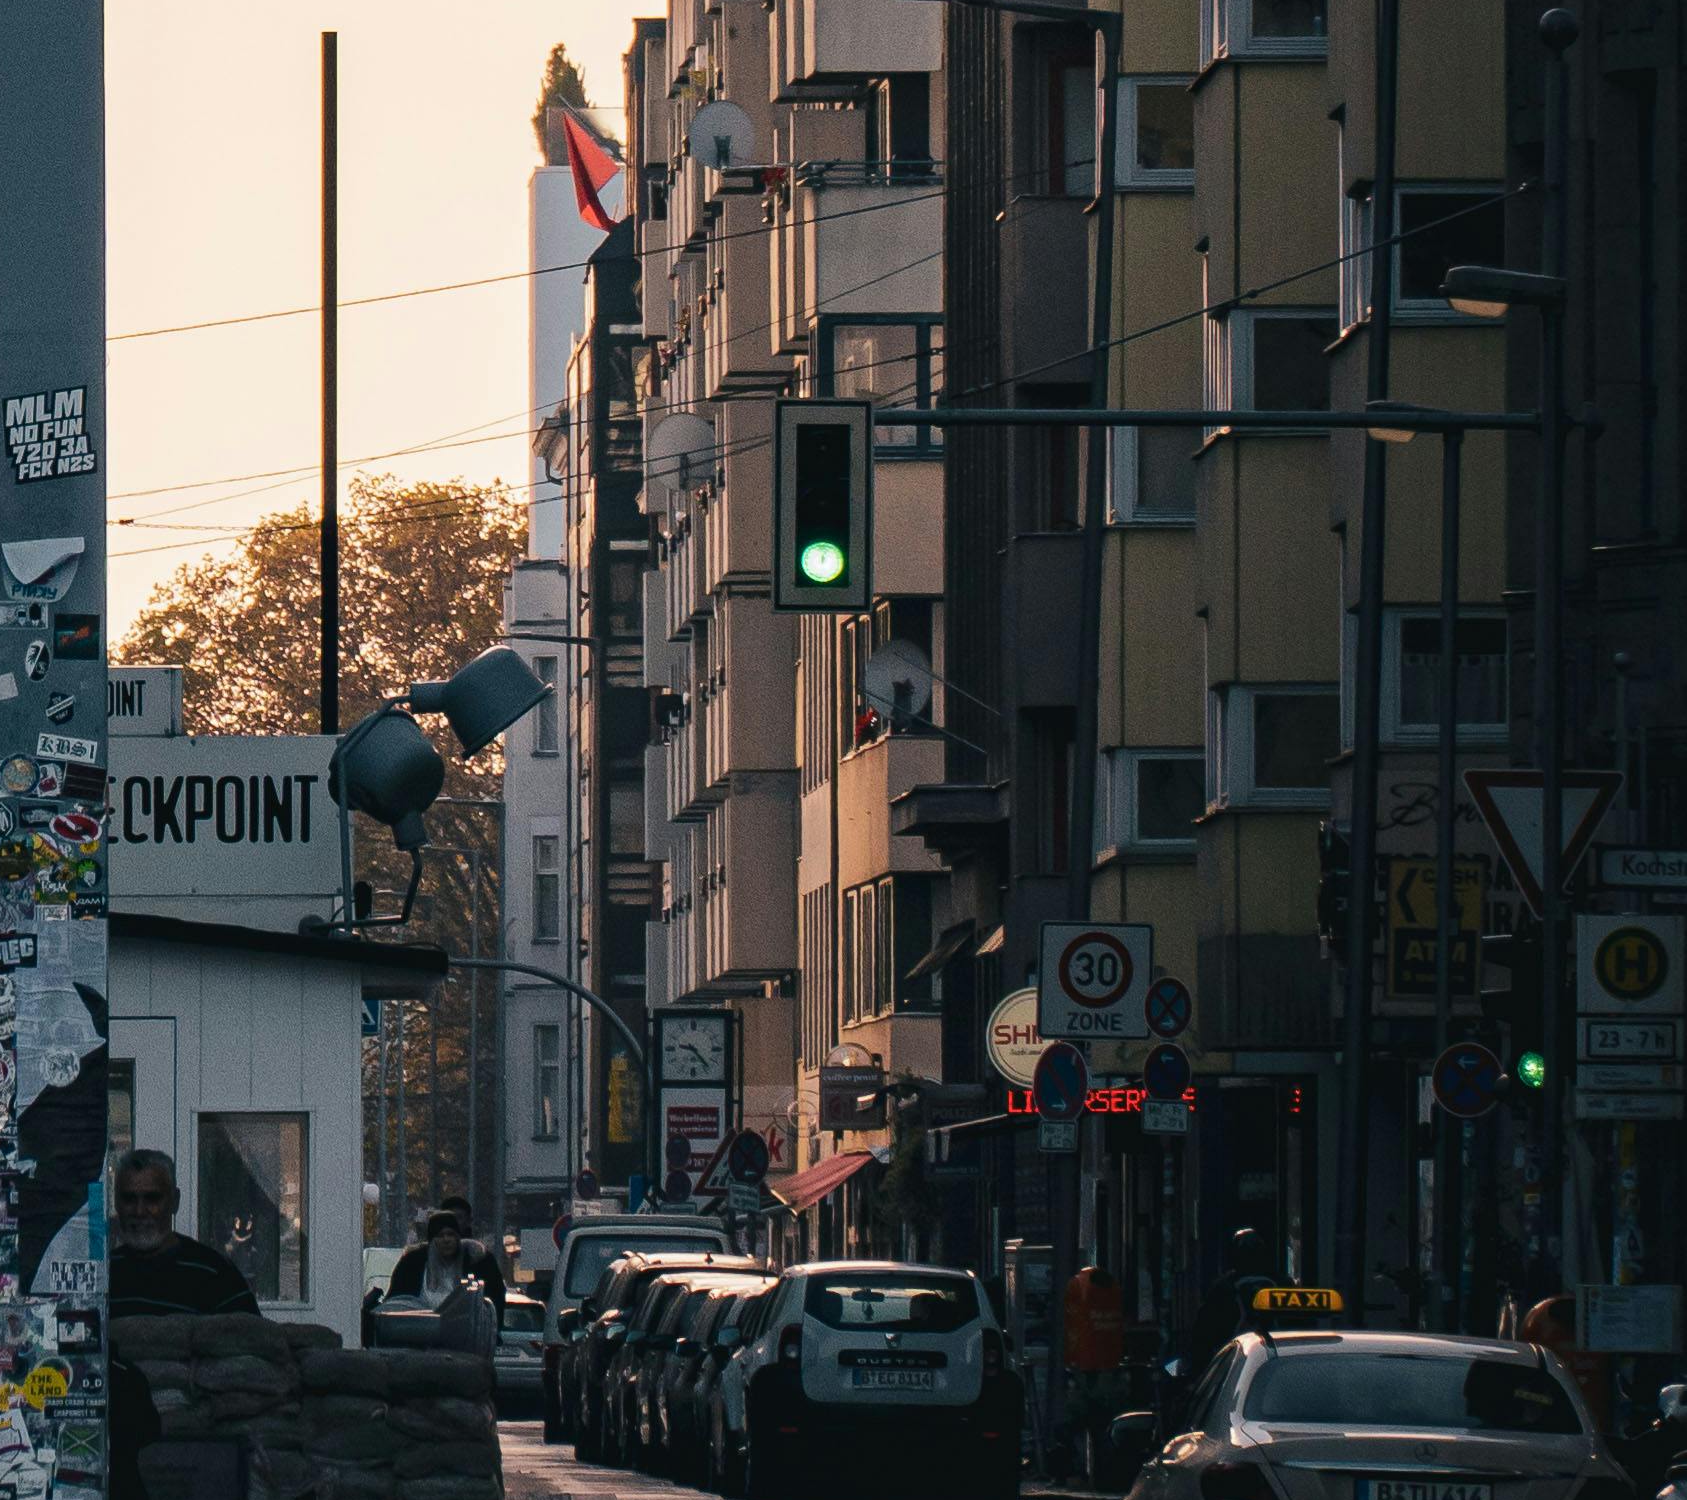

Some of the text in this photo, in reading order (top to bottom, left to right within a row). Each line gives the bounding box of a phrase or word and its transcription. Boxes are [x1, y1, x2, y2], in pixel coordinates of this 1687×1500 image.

[5, 388, 84, 427] MLM
[9, 417, 83, 446] NO FUN
[12, 436, 88, 464] 720 3A
[18, 460, 54, 480] FCK
[108, 776, 318, 845] CKPOINT
[1623, 854, 1687, 875] Kochst
[1075, 952, 1118, 987] 30
[1067, 1012, 1123, 1031] ZONE
[1599, 1031, 1620, 1048] 23
[1639, 1031, 1649, 1048] 7
[1655, 1031, 1665, 1048] h
[1272, 1293, 1327, 1307] TAXI
[856, 1357, 929, 1366] DUSTER
[31, 1375, 53, 1383] THE
